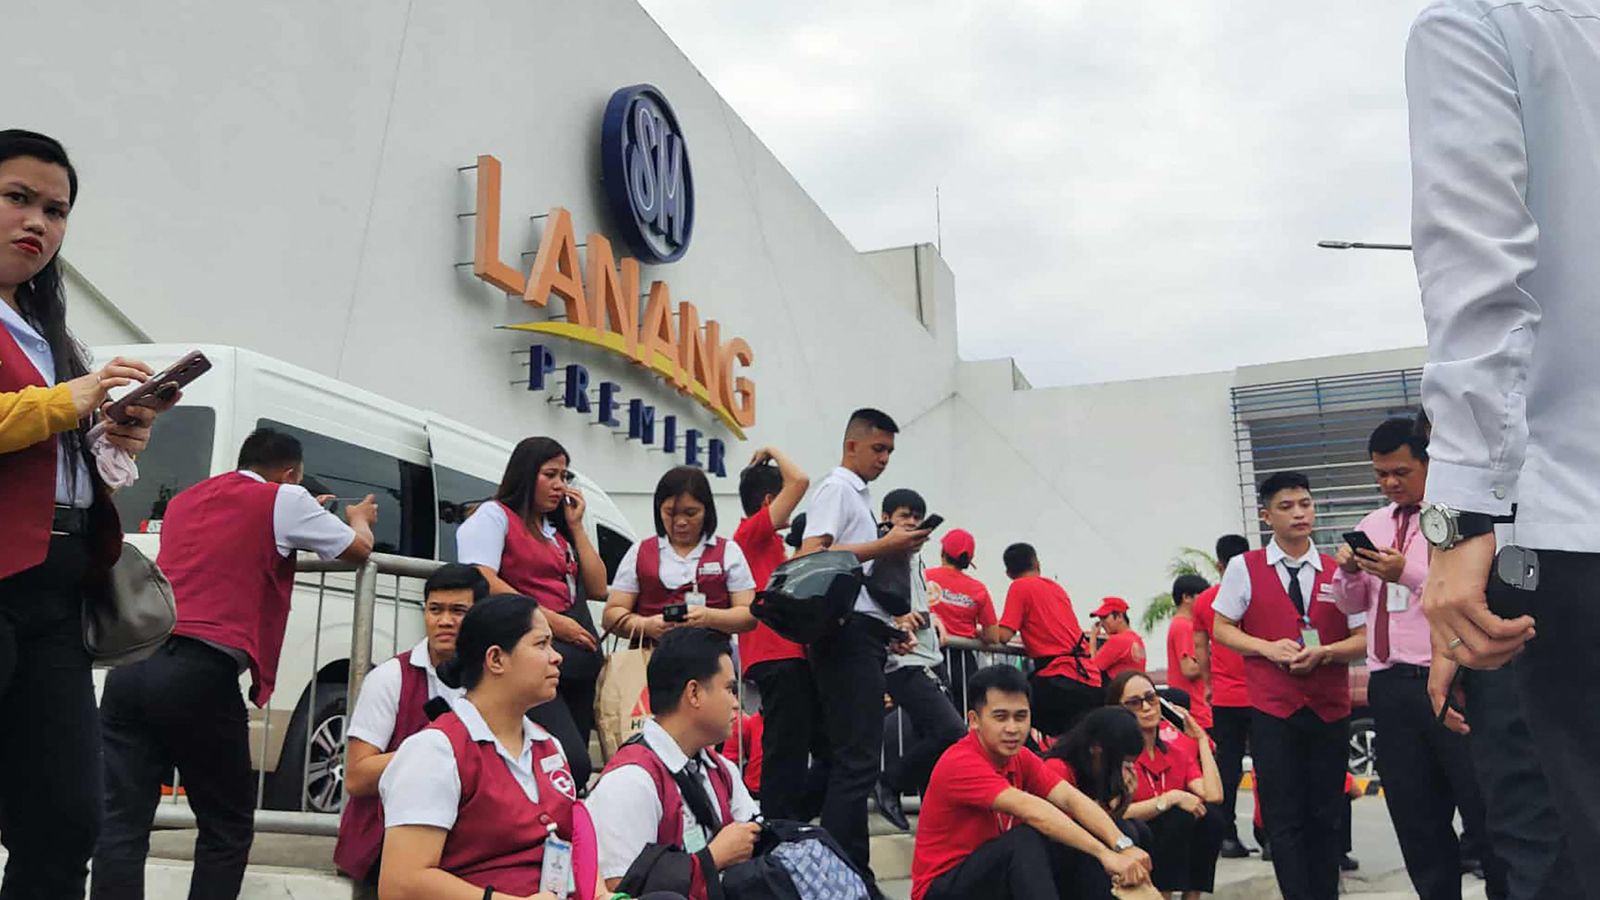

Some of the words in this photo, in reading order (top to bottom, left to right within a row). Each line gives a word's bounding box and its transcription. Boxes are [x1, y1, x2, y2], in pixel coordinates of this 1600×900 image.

[627, 98, 685, 247] SM
[474, 154, 756, 428] LANANG
[528, 344, 727, 478] PREMIER
